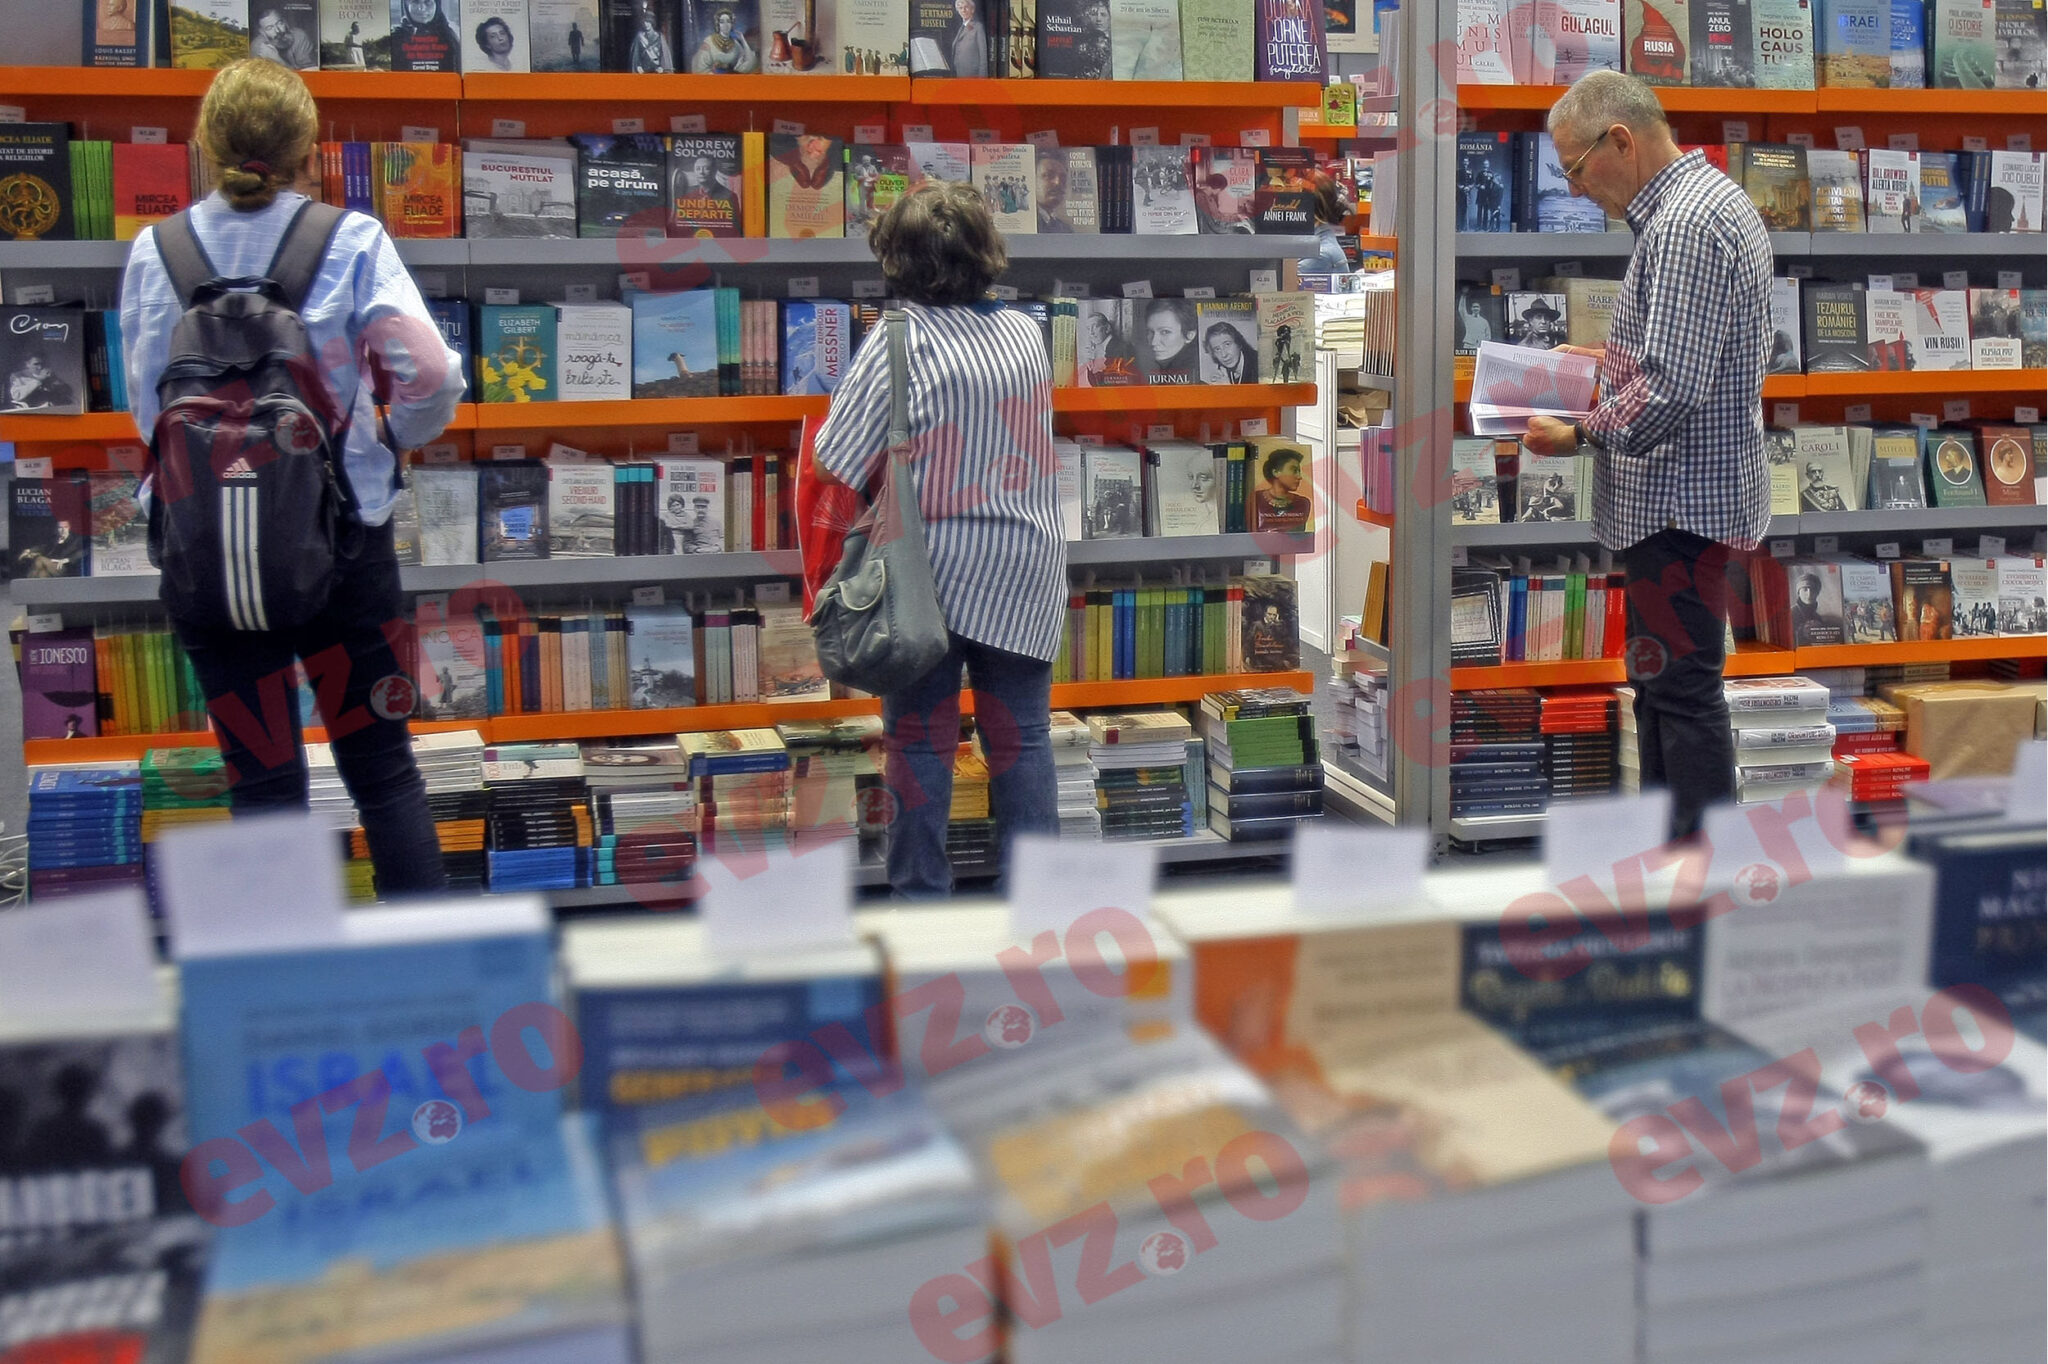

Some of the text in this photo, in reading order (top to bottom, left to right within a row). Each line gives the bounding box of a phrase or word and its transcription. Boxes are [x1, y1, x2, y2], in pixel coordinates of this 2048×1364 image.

[338, 12, 374, 20] BOCA
[920, 9, 953, 18] BERTRAND
[921, 19, 946, 28] RUSSELL
[1046, 15, 1072, 24] Mihail
[1708, 17, 1731, 25] ANUL
[1954, 19, 1983, 31] ISTORIE
[1046, 24, 1082, 33] Sebastian
[1266, 17, 1318, 44] CORNEA
[1561, 15, 1615, 36] GULAGUL
[1760, 27, 1803, 40] HOLO
[1643, 40, 1675, 53] RUSIA
[1760, 41, 1804, 54] CAUS
[1267, 43, 1321, 67] PUTEREA
[23, 136, 52, 144] ELIADE
[675, 140, 735, 150] ANDREW
[1459, 142, 1493, 151] ROMÂNIA
[675, 148, 735, 159] SOLOMON
[510, 174, 554, 183] MUTILAT
[588, 167, 645, 180] acasă,
[588, 178, 658, 190] pe drum
[135, 194, 179, 204] MIRCEA
[404, 194, 444, 205] MIRCEA
[677, 198, 731, 209] UNDEVA
[135, 204, 179, 215] ELIADE
[404, 205, 444, 216] ELIADE
[677, 209, 733, 220] DEPARTE
[1263, 210, 1307, 222] ANNEI FRANK
[1204, 302, 1253, 310] HANNAH ARENDT
[1816, 301, 1856, 316] TEZAURUL
[499, 319, 541, 327] ELIZABETH
[1817, 315, 1856, 328] ROMÂNIEI
[503, 326, 536, 334] GILBERT
[1817, 329, 1857, 338] DE LA MOSCOVA
[825, 308, 838, 377] MESSNER
[1924, 337, 1938, 349] VIN
[1149, 374, 1190, 384] JURNAL
[1801, 443, 1833, 453] CAROL
[17, 488, 52, 496] LUCIAN
[17, 496, 52, 504] BLAGA
[40, 648, 87, 664] IONESCO
